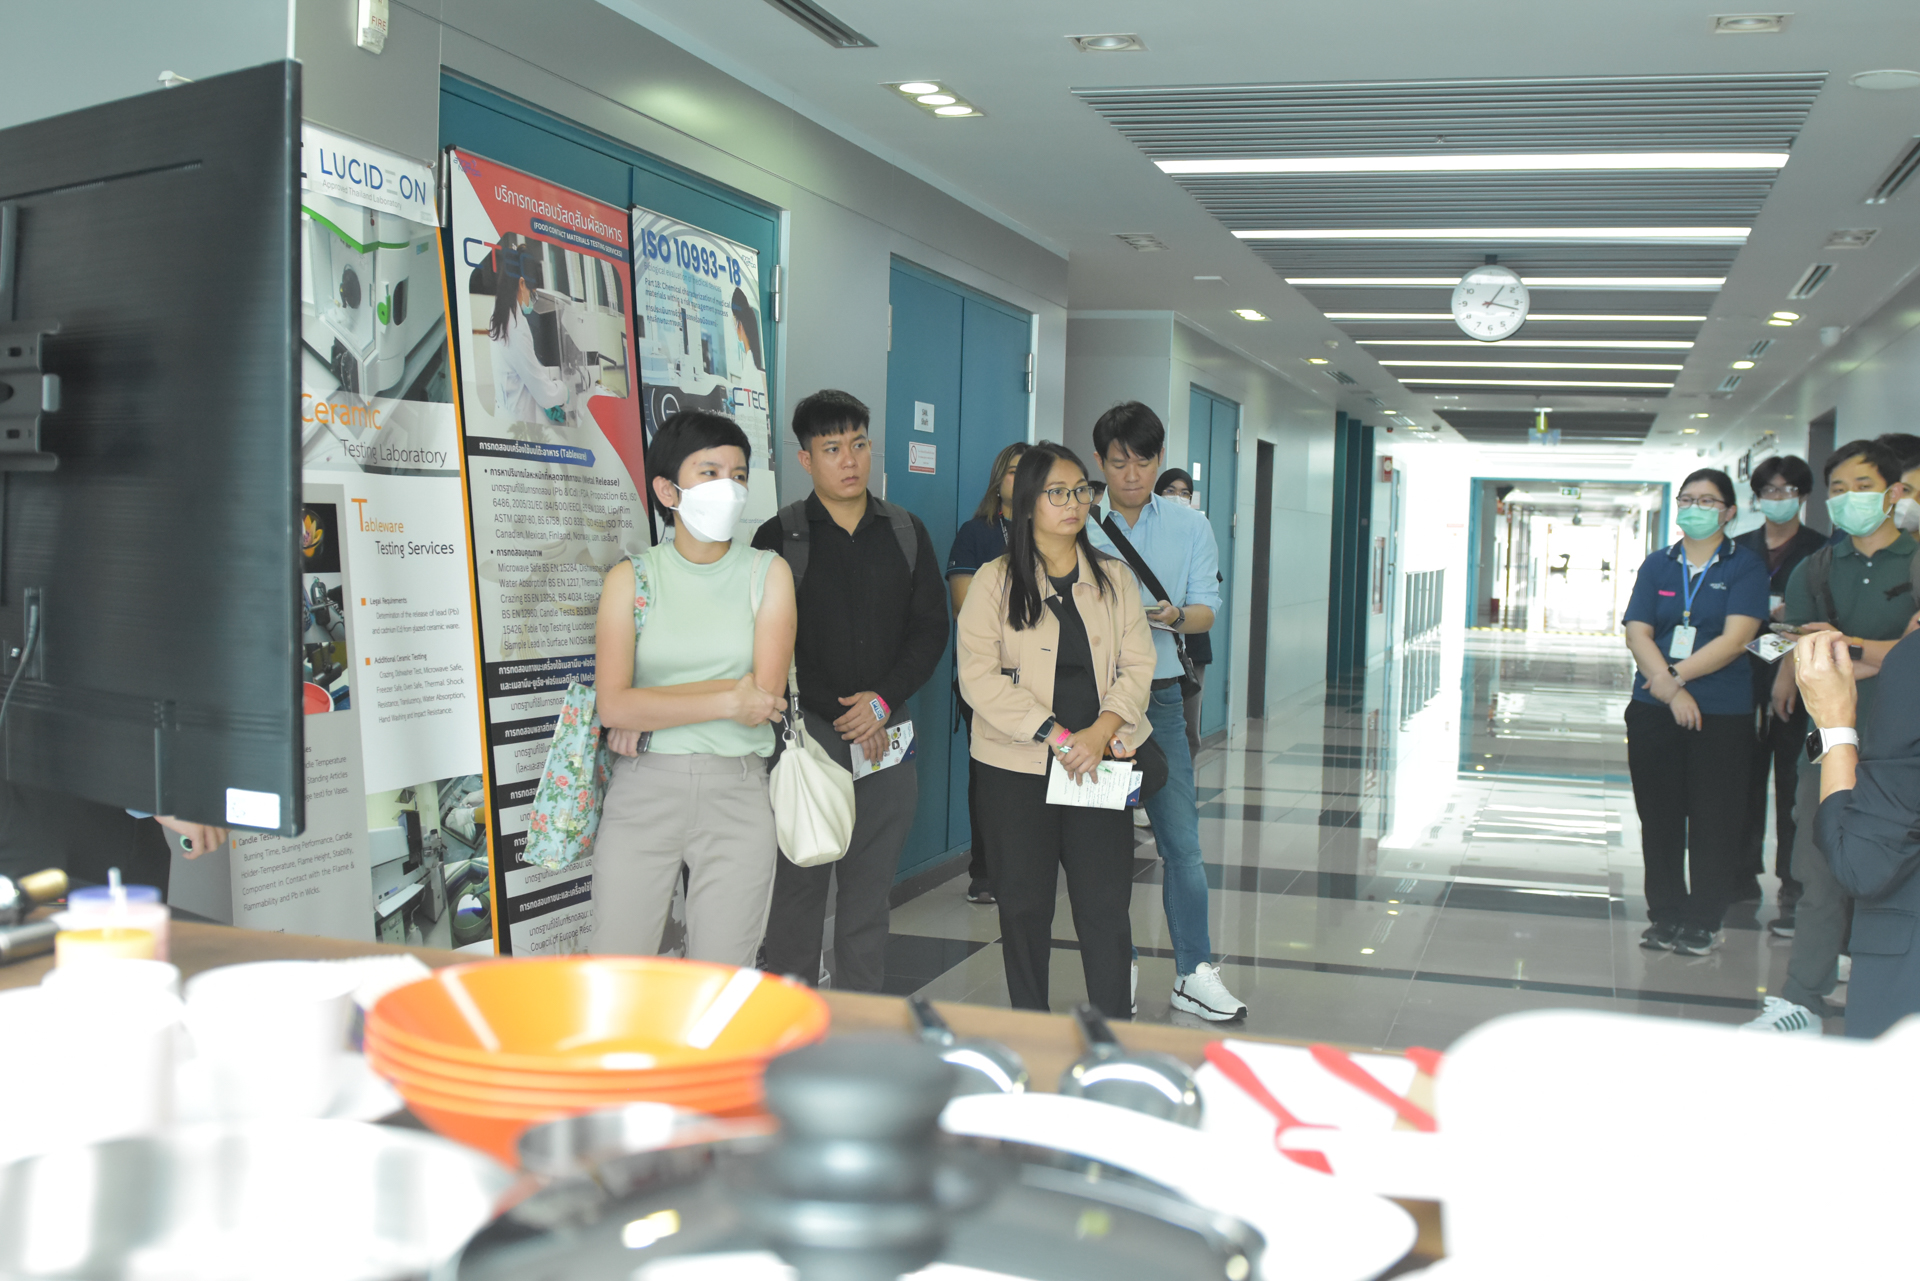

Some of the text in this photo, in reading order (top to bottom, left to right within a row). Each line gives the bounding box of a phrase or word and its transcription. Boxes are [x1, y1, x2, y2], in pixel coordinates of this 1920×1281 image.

[372, 16, 386, 31] FIRE
[322, 179, 402, 211] Approved Thailand Laboratory
[494, 185, 623, 243] บริการทดสอบวัสดุสัมผัสอาหาร
[549, 226, 566, 238] CONTACT
[567, 233, 590, 245] MATERIALS
[590, 239, 605, 251] TESTING
[641, 228, 741, 287] ISO 10993-18
[645, 278, 654, 287] Part
[662, 282, 680, 293] Chemical
[733, 387, 766, 411] CTEC
[301, 393, 382, 430] Ceramic
[340, 439, 447, 468] Testing Laboratory
[595, 476, 620, 487] Release)
[493, 497, 512, 509] 6486,
[351, 498, 404, 533] Tableware
[494, 513, 635, 530] ASTM ISO ISO 7086,
[495, 528, 525, 539] Canadian,
[525, 529, 548, 540] Mexican,
[549, 530, 573, 541] Finland,
[375, 540, 454, 558] Testing Services
[496, 549, 543, 560] การทดสอบคุณภาพ
[497, 563, 530, 573] Microwave
[529, 562, 542, 572] Safe
[542, 563, 550, 573] BS
[550, 563, 559, 573] EN
[499, 578, 518, 588] Water
[519, 578, 548, 590] Absorption
[548, 578, 557, 588] BS
[557, 578, 566, 587] EN
[370, 598, 381, 606] Legal
[500, 592, 583, 606] Crazing BS EN BS 4034,
[435, 608, 447, 616] lead
[448, 608, 459, 616] (Pb)
[501, 609, 511, 619] BS
[512, 609, 521, 619] EN
[540, 608, 559, 618] Candle
[559, 607, 576, 617] Tests
[427, 623, 445, 631] ceramic
[524, 624, 539, 634] Table
[539, 623, 550, 634] Top
[550, 623, 572, 634] Testing
[503, 640, 527, 651] Sample
[527, 639, 540, 649] Lead
[546, 637, 568, 647] Surface
[374, 655, 396, 664] Additional
[411, 653, 427, 662] Testing
[423, 665, 448, 674] Microwave
[376, 685, 393, 693] Freezer
[424, 680, 445, 688] Thermal
[436, 692, 466, 700] Absorption,
[427, 707, 453, 715] Resistance.
[315, 756, 347, 768] Temperature
[307, 771, 348, 784] Standing Articles
[333, 786, 349, 795] Vases.
[238, 835, 258, 846] Candle
[243, 831, 353, 862] Burning Time, Burning Performance, Candle
[241, 847, 354, 879] Holder-Temperature, Flame Height, Stability,
[242, 882, 277, 895] Component
[285, 874, 307, 885] Contact
[308, 871, 320, 879] with
[332, 864, 349, 874] Flame
[243, 898, 278, 911] Flammability
[280, 894, 290, 902] and
[291, 892, 298, 900] Pb
[305, 886, 320, 896] Wicks.
[530, 929, 579, 952] Council of Europe
